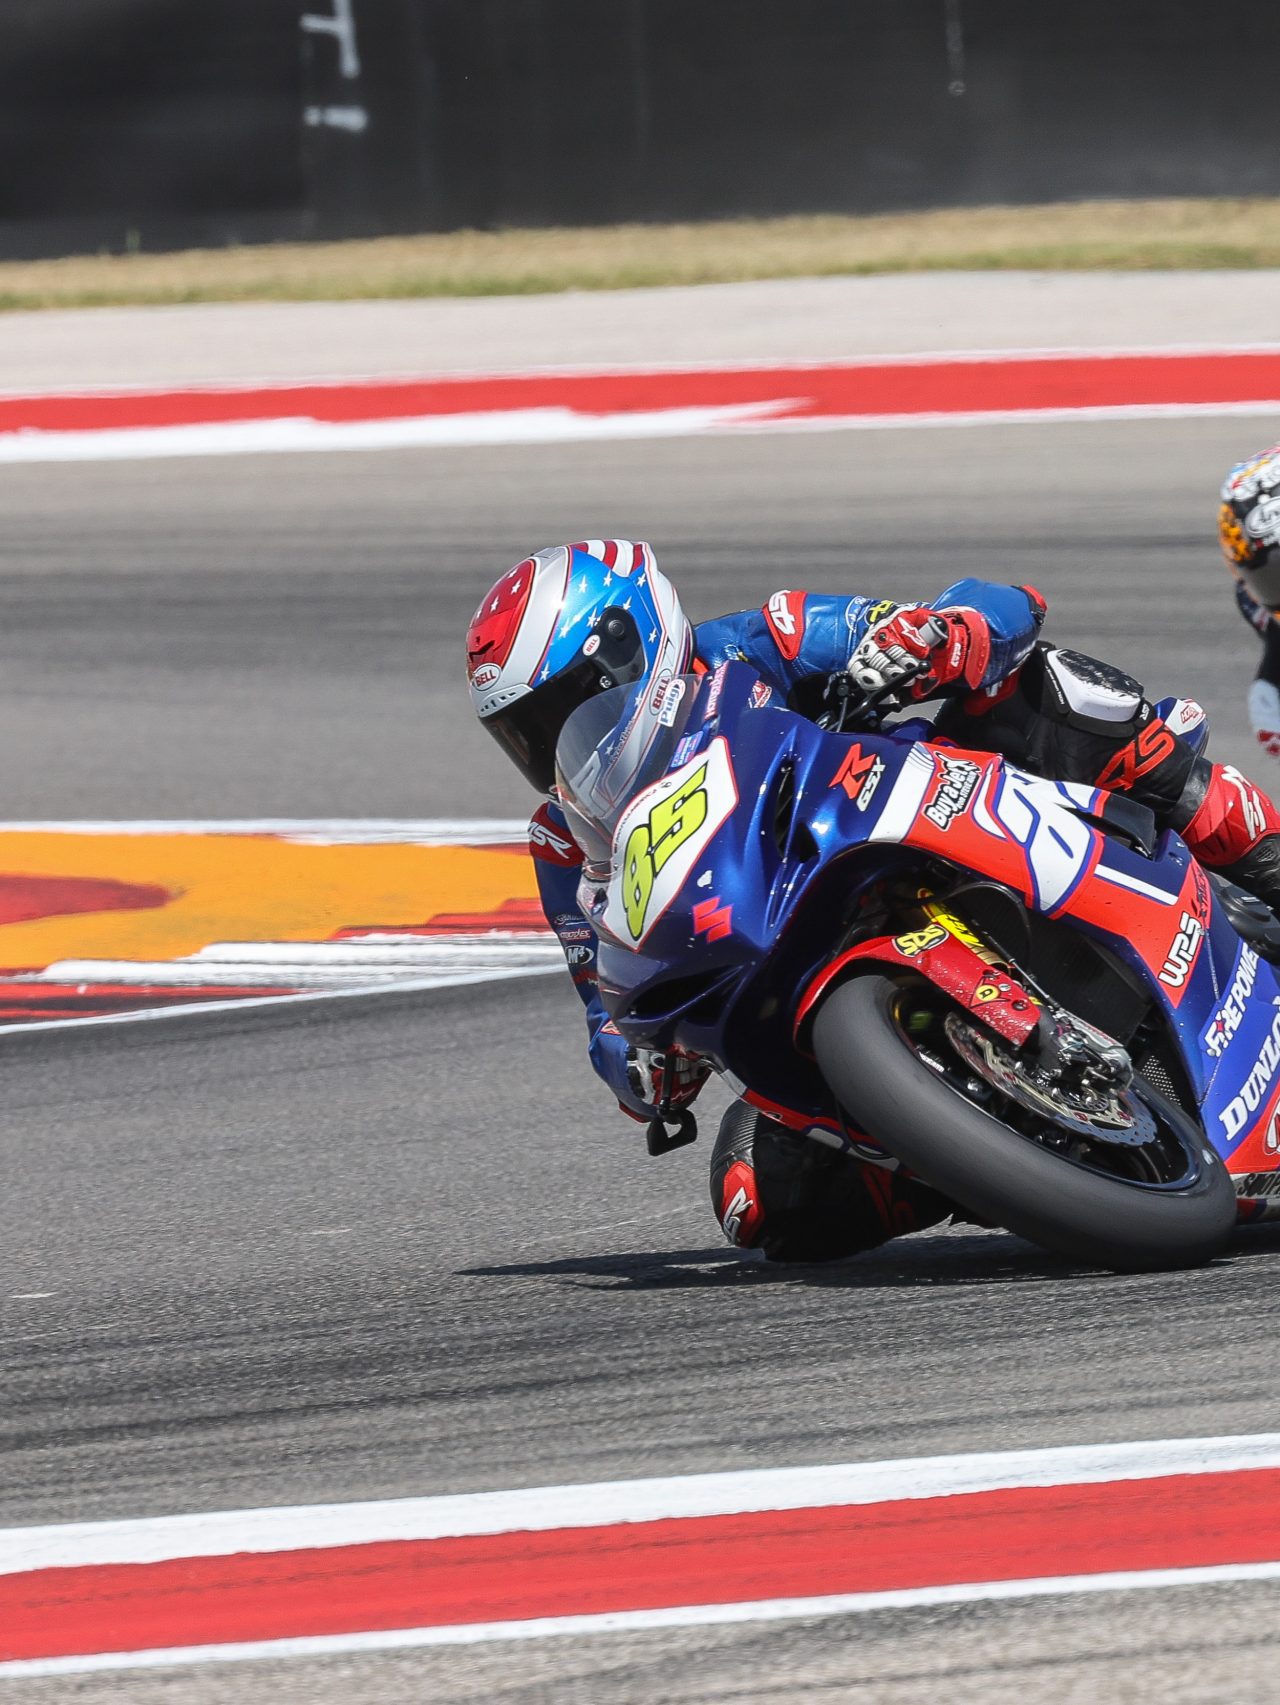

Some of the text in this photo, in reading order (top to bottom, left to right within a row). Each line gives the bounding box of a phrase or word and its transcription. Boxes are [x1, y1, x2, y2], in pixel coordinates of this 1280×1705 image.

[585, 637, 599, 653] BELL
[475, 670, 497, 687] BELL
[652, 675, 671, 710] BELL
[660, 683, 681, 724] Puig
[925, 766, 967, 827] Buy a Jet
[622, 759, 709, 941] 85
[1158, 911, 1204, 987] WPS
